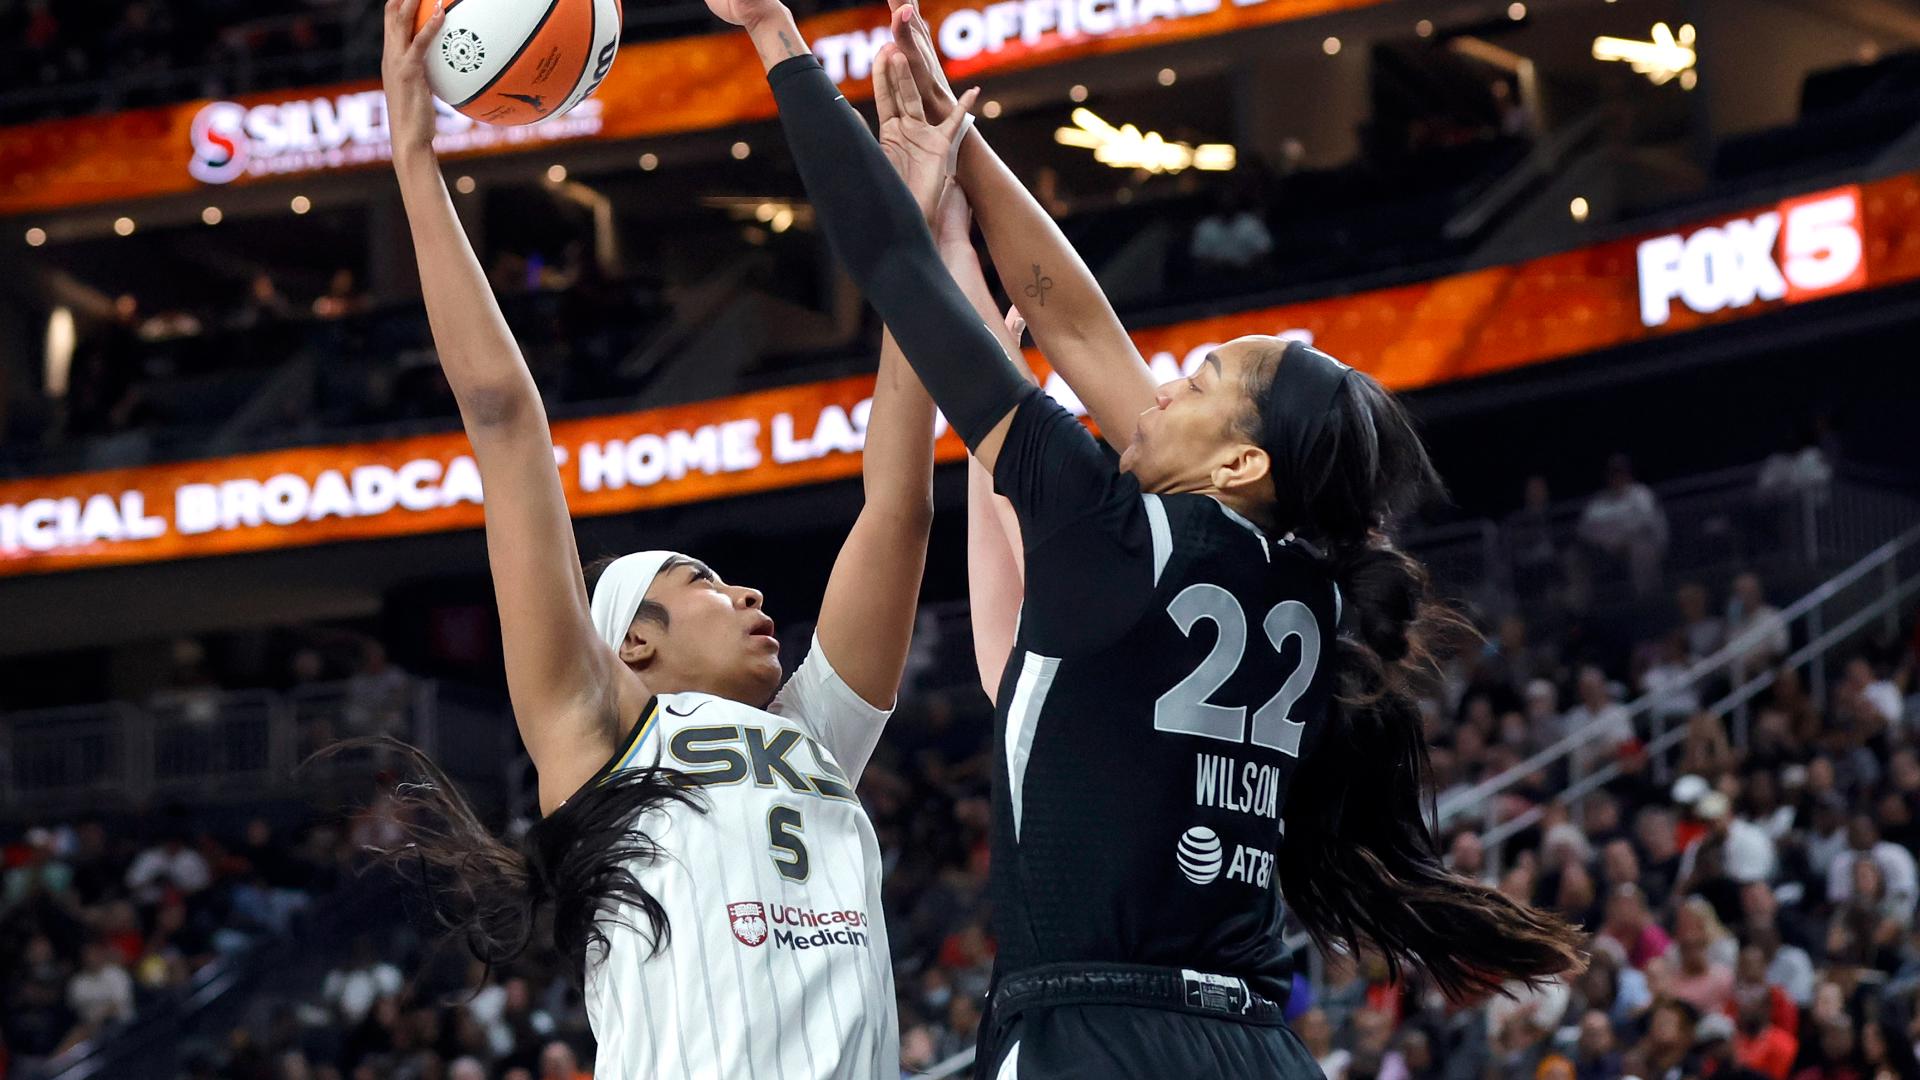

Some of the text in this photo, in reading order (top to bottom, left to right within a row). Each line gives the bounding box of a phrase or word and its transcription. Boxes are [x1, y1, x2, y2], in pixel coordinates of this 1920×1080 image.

[812, 21, 930, 84] TH
[244, 90, 391, 157] SILVE
[1637, 194, 1863, 327] FOX 5
[175, 445, 568, 535] BROADCA
[579, 419, 761, 491] HOME
[1154, 583, 1321, 758] 22
[1196, 753, 1280, 819] WILSON
[770, 903, 868, 927] UChicago
[773, 916, 869, 951] Medicin
